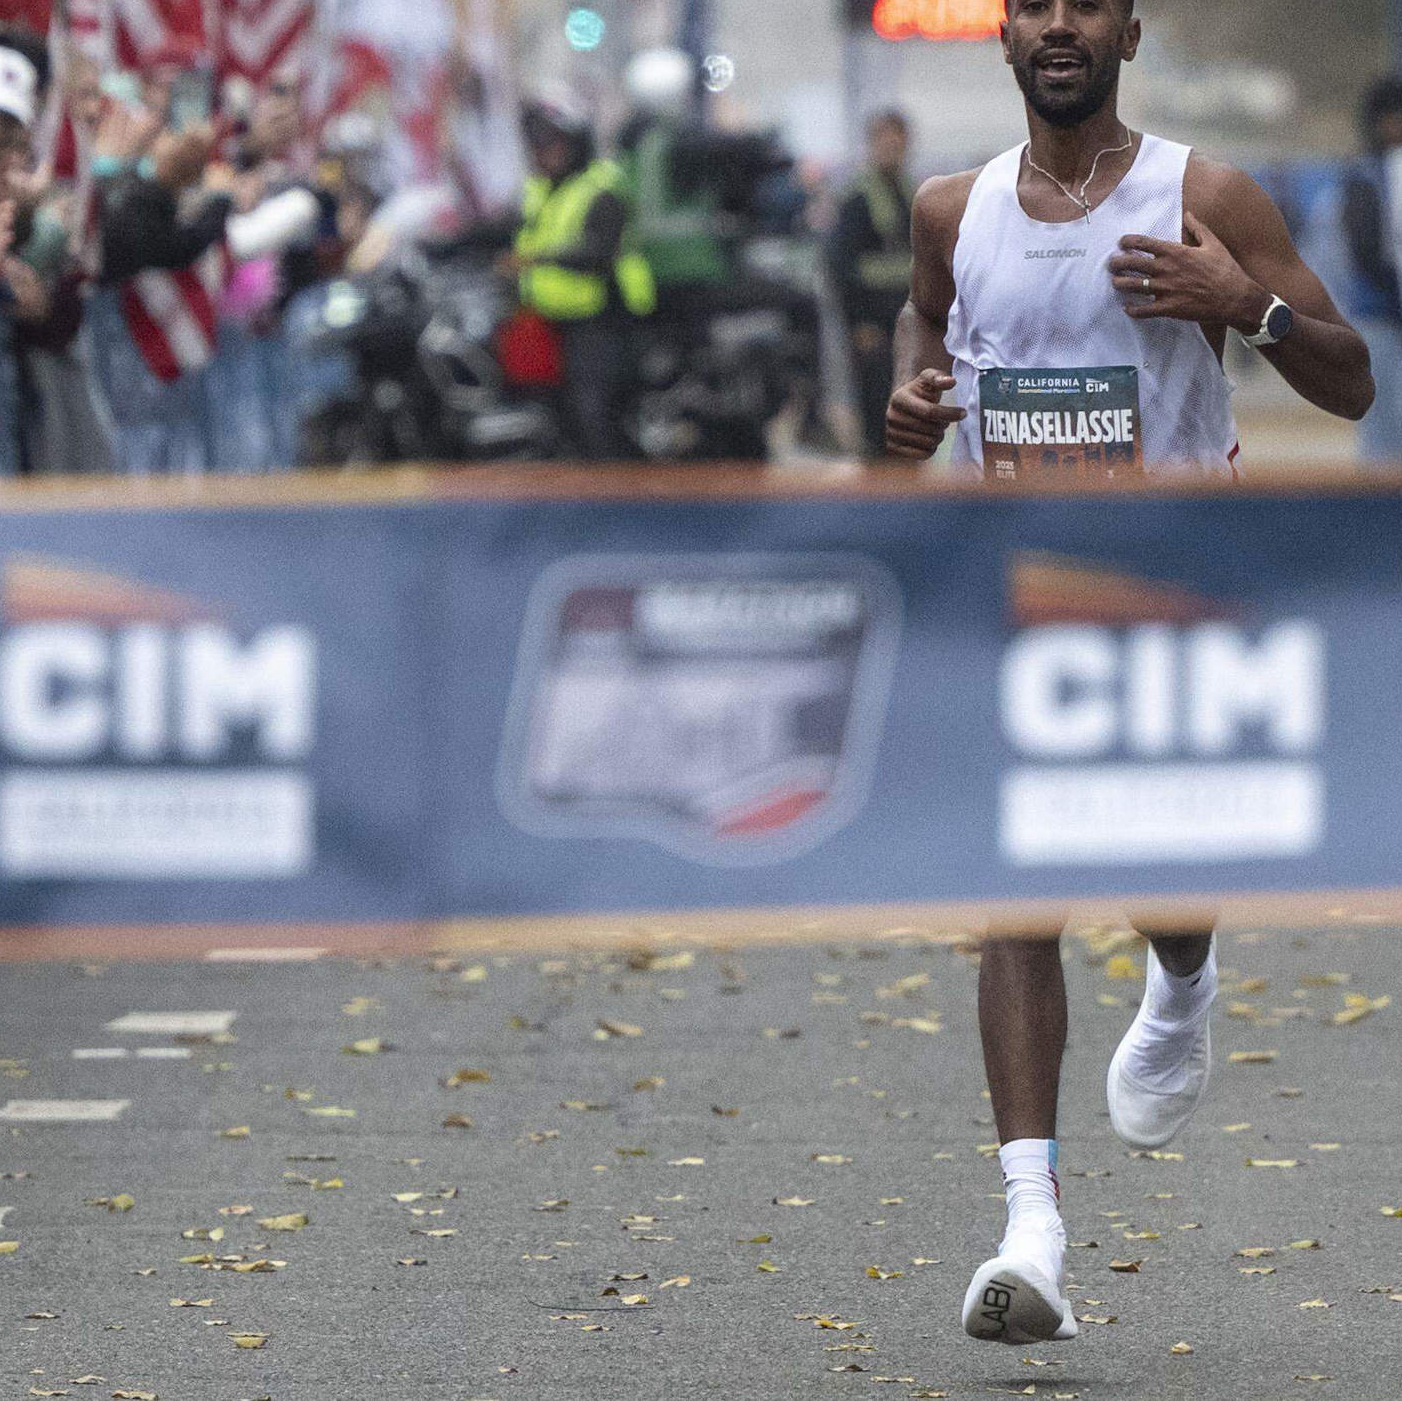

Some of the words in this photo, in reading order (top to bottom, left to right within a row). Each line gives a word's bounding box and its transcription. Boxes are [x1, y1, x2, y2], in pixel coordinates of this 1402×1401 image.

[1024, 248, 1087, 259] SALOMON
[1017, 377, 1080, 387] CALIFORNIA
[1086, 382, 1109, 393] CIM
[983, 409, 1134, 444] ZIENASELLASSIE
[999, 615, 1324, 758] CIM
